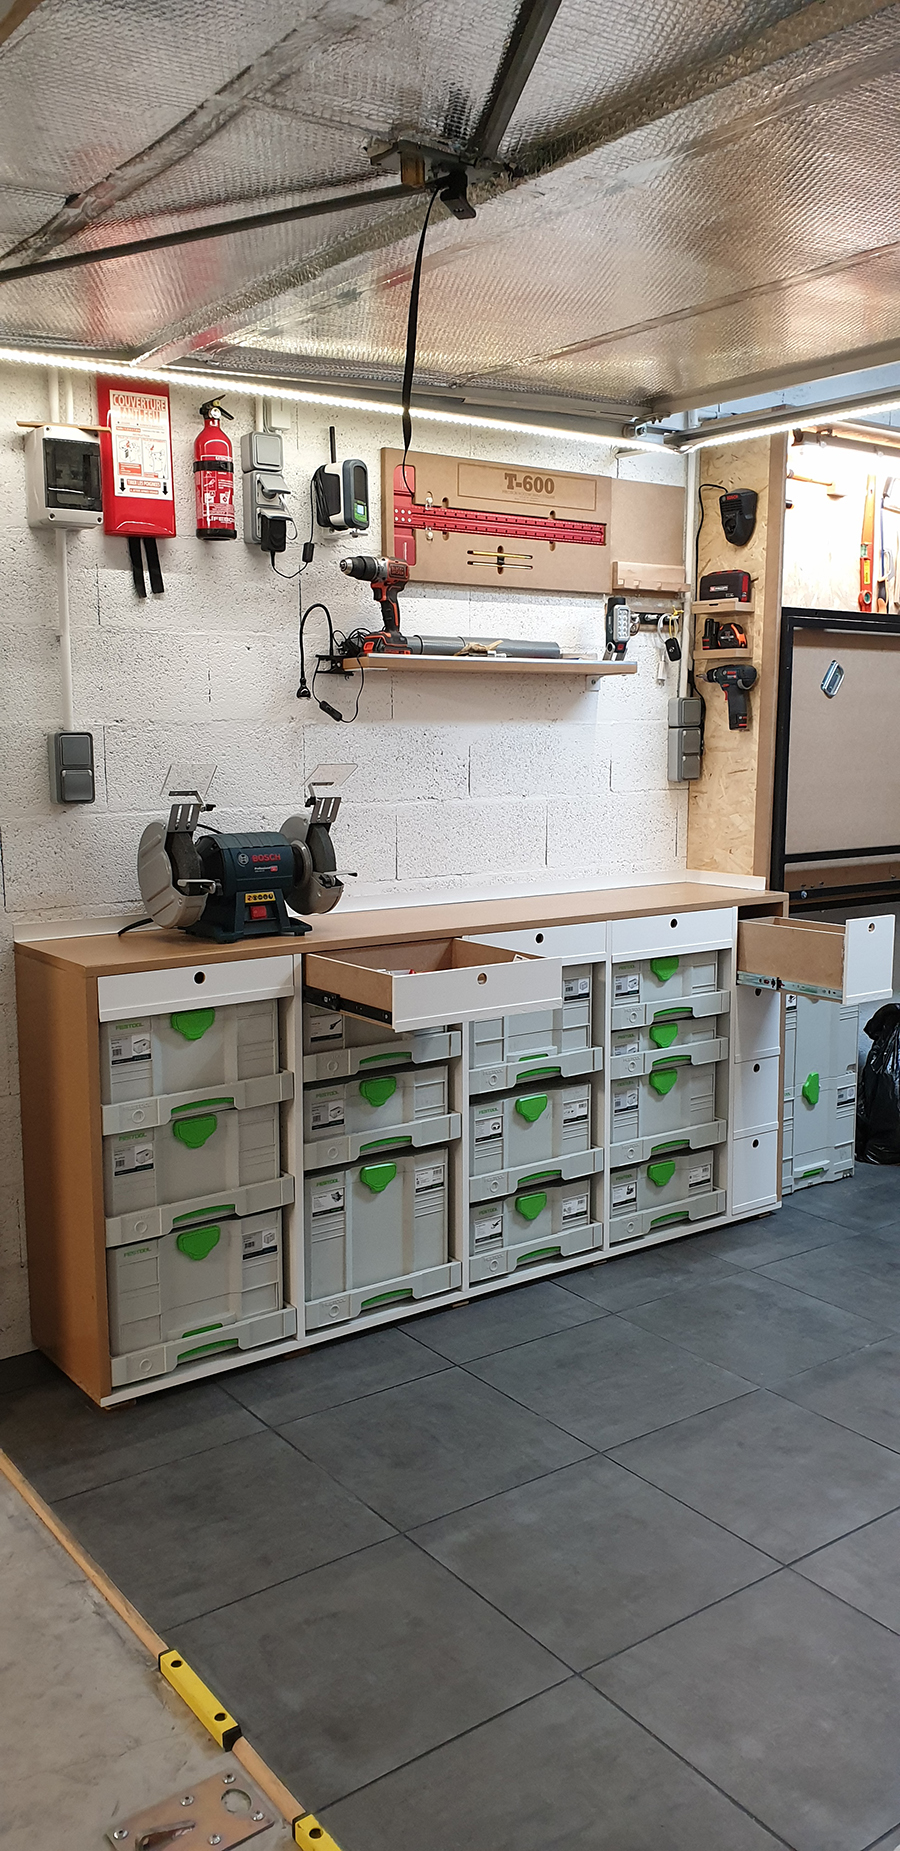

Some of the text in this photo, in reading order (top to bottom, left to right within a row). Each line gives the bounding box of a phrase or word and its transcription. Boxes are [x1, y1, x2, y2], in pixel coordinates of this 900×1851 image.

[113, 394, 166, 411] COUVERTURE
[504, 472, 555, 495] T-600
[251, 854, 281, 863] BOSCH
